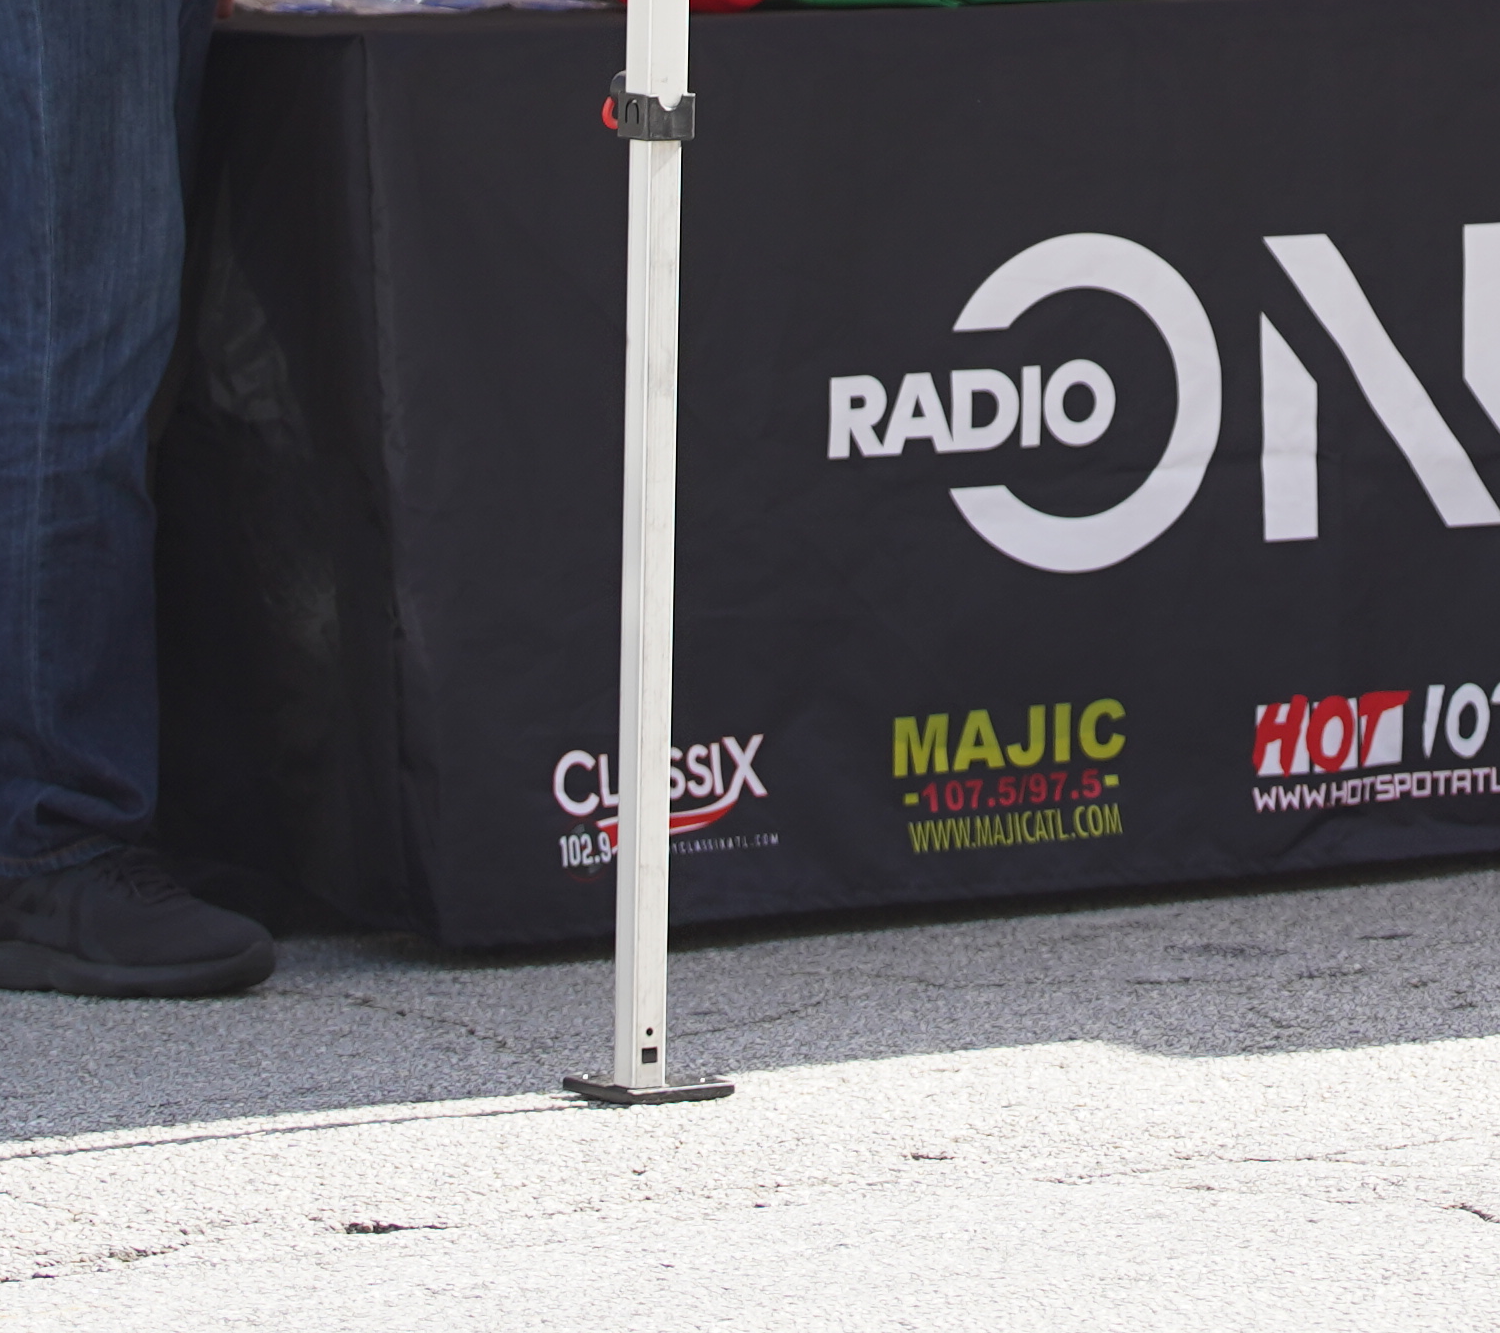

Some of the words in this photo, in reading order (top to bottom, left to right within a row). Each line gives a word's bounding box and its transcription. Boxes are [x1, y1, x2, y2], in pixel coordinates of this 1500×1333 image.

[828, 358, 1116, 459] RADIO
[892, 699, 1126, 777] MAJIC
[1252, 690, 1412, 777] HOT
[553, 733, 768, 817] CLSSIX
[560, 832, 612, 868] 102.9
[909, 804, 1123, 853] WWW.MAJICATL.COM
